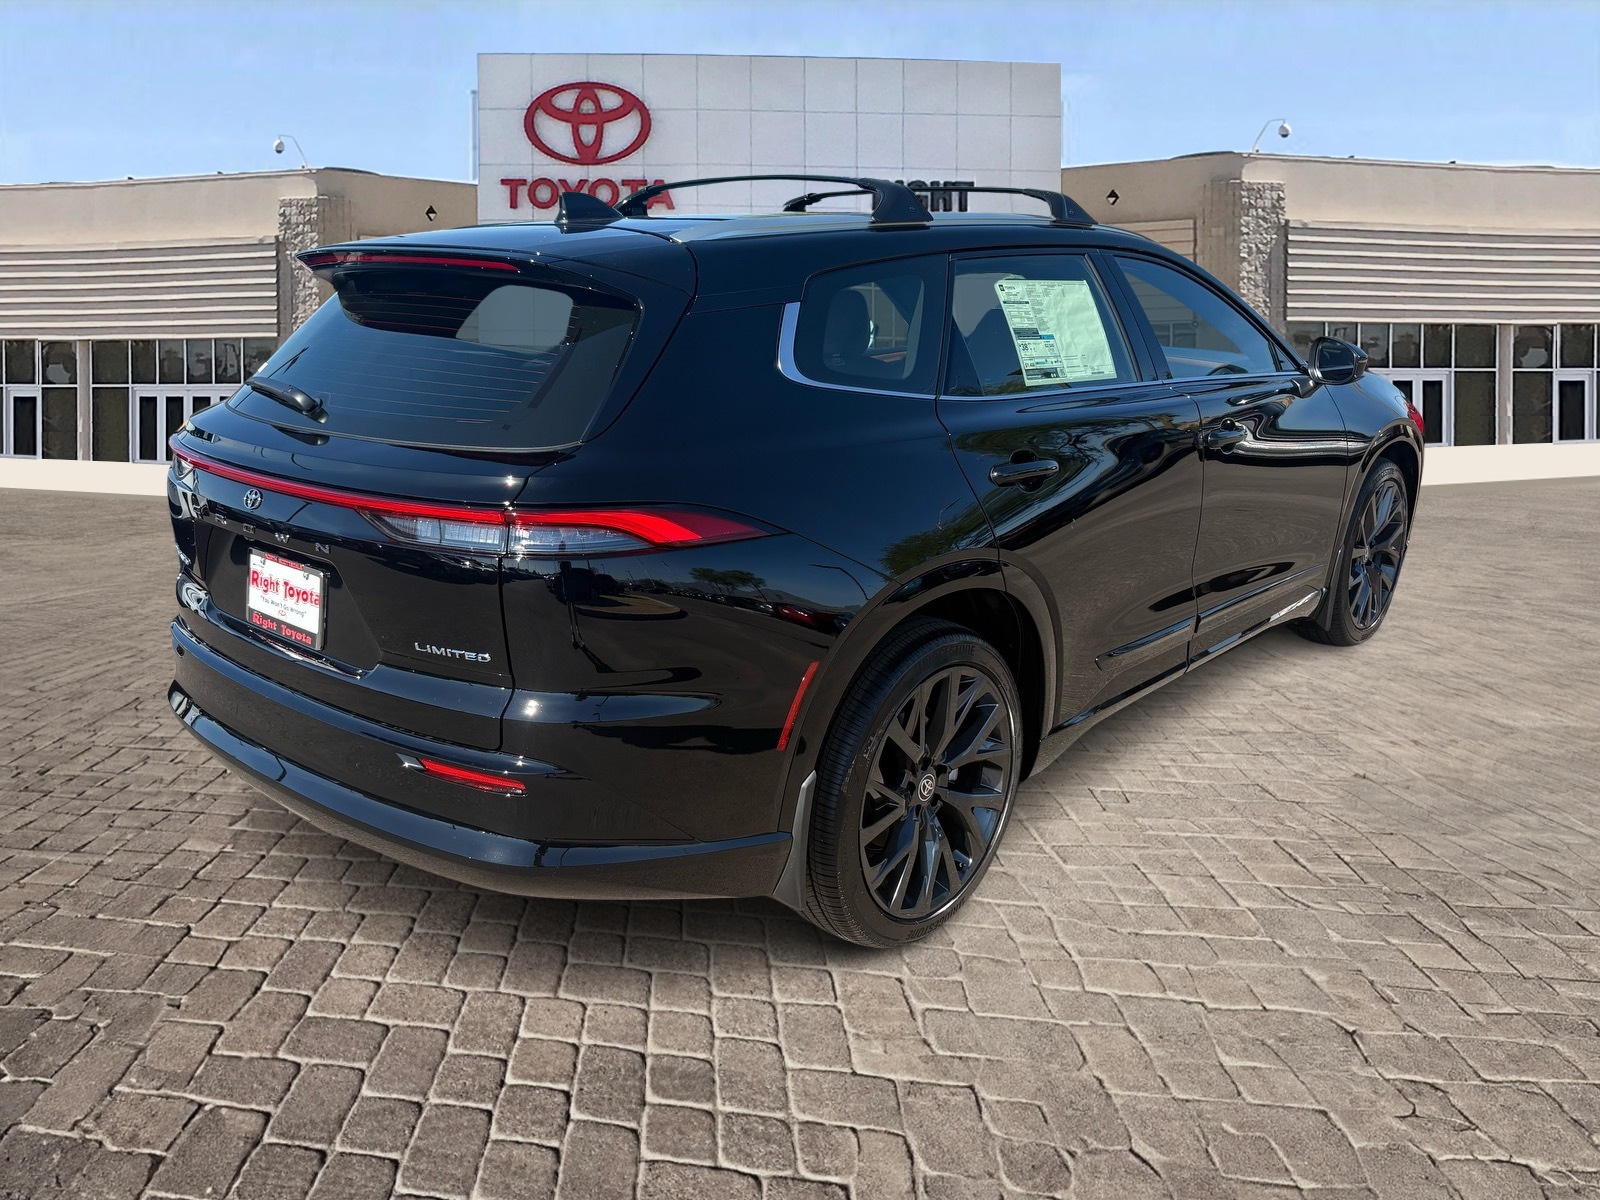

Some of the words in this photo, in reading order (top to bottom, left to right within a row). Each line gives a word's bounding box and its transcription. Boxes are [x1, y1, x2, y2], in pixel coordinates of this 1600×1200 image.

[872, 180, 975, 212] GHT
[251, 569, 280, 594] Right
[283, 580, 320, 606] Toyota
[252, 612, 278, 630] Right
[280, 624, 312, 645] Toyota
[414, 642, 492, 663] LIMITED
